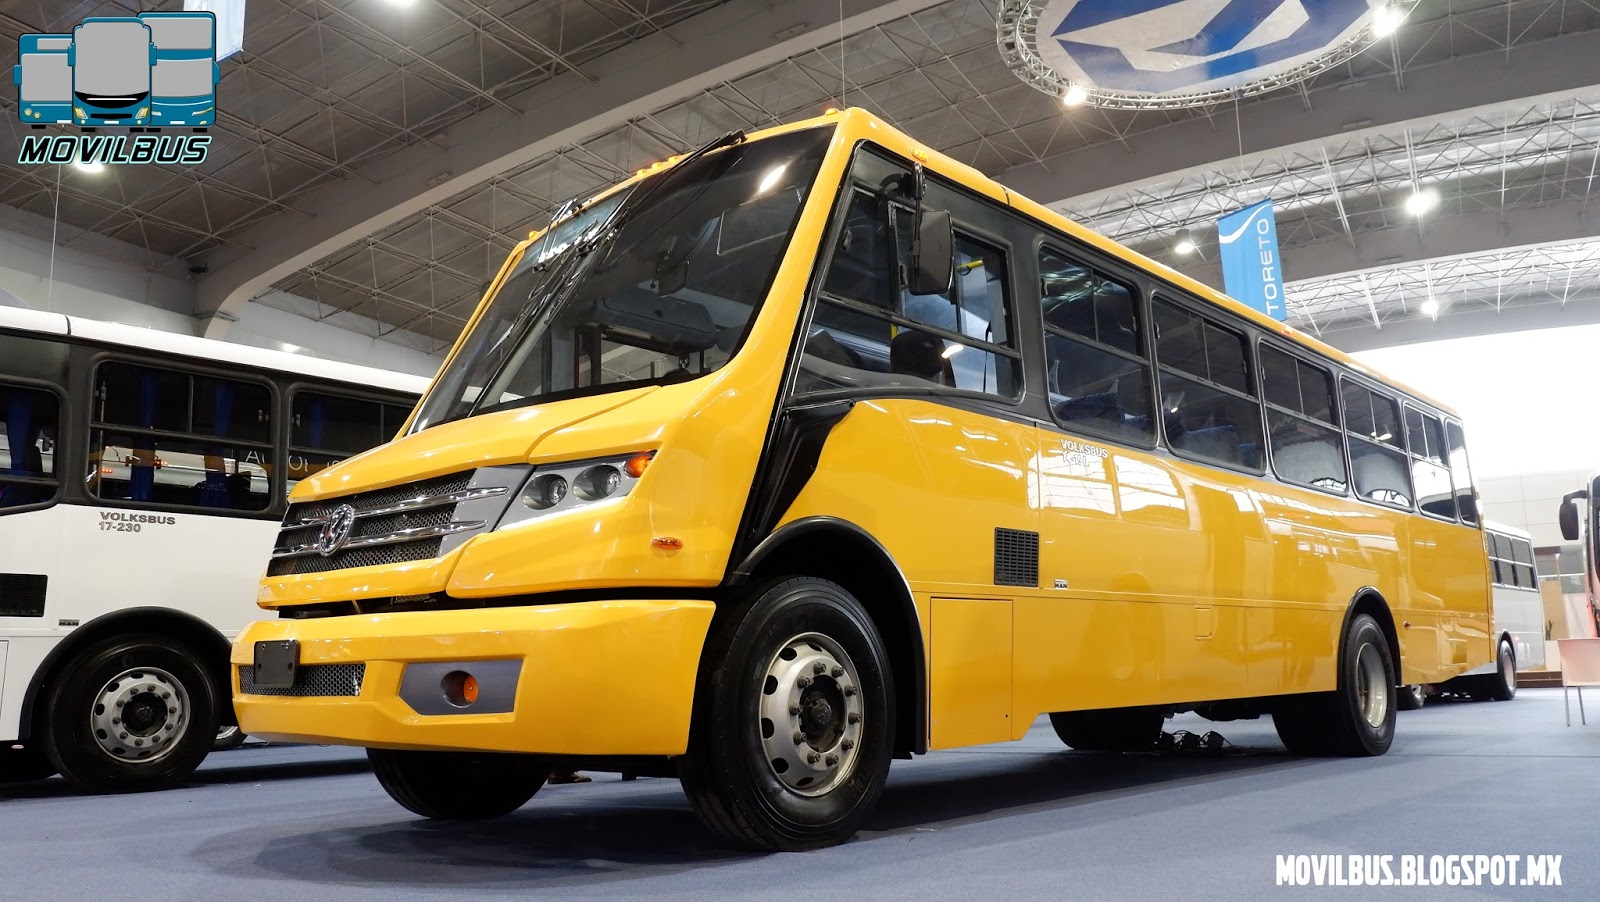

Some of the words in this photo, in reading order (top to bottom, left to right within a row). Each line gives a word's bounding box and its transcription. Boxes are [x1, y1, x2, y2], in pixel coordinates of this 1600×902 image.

[1257, 218, 1279, 316] TORETO
[1060, 439, 1108, 458] VOLKSBUS
[100, 511, 176, 525] VOLKSBUS
[99, 521, 141, 533] 17-230
